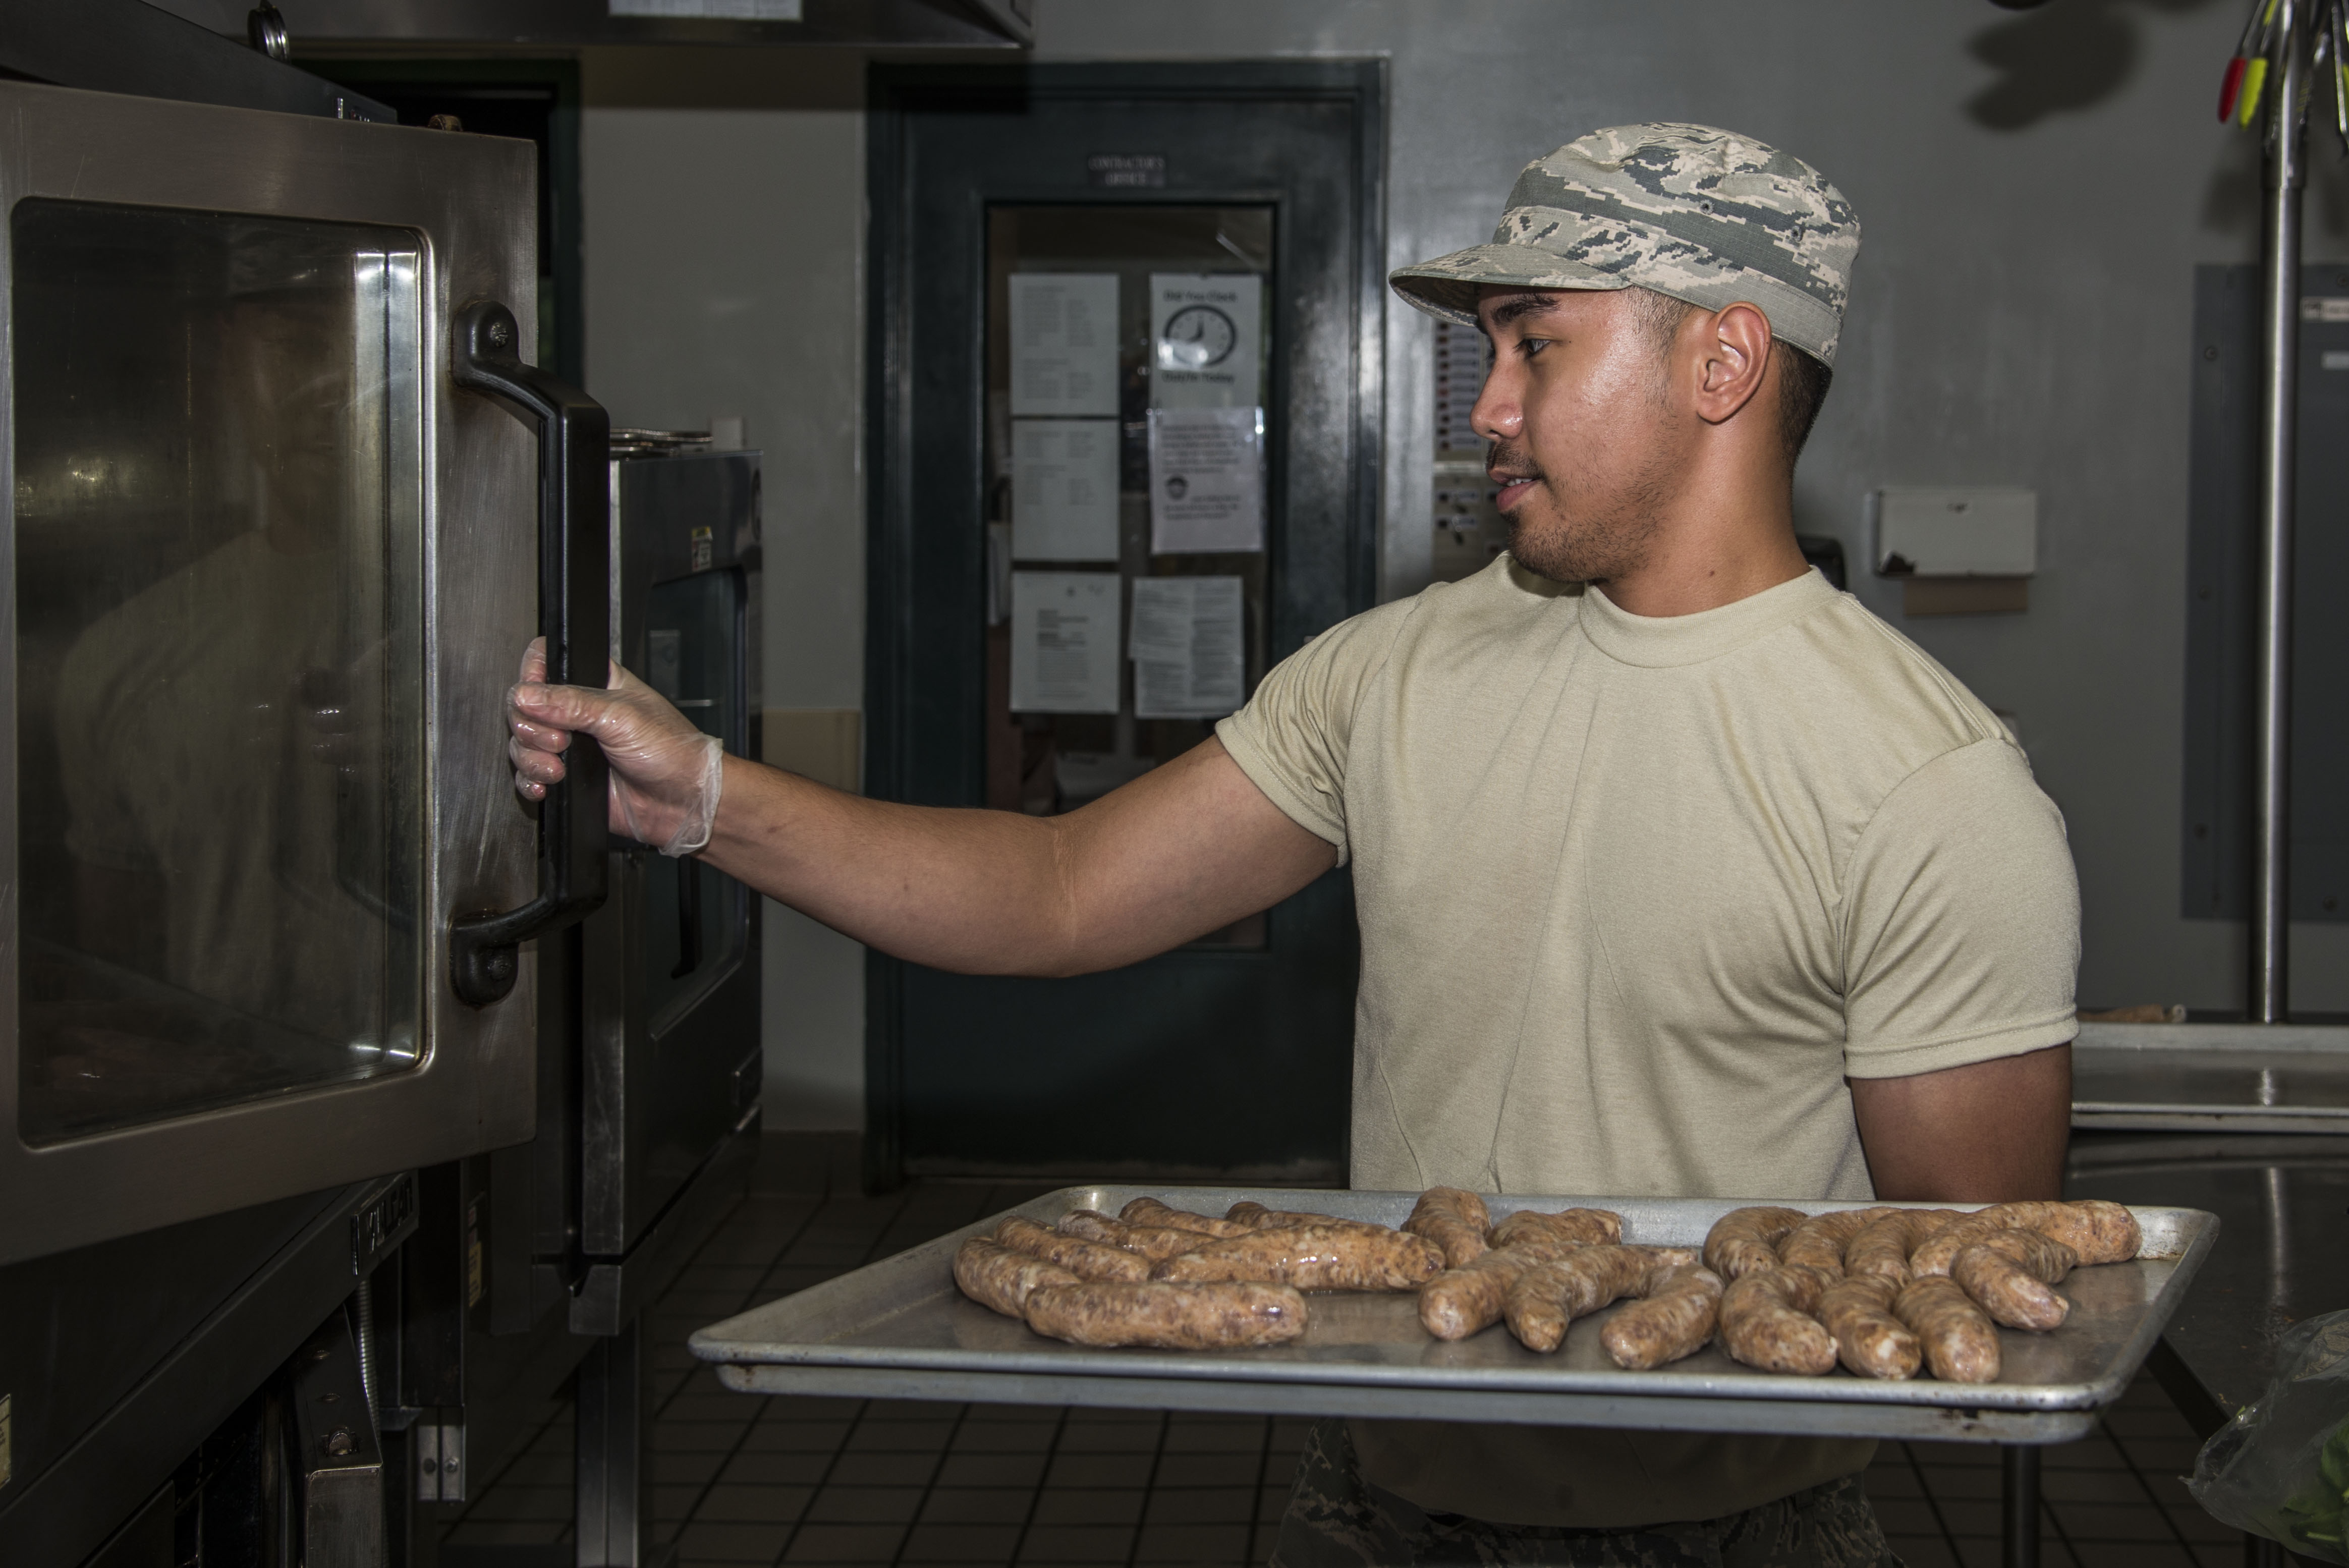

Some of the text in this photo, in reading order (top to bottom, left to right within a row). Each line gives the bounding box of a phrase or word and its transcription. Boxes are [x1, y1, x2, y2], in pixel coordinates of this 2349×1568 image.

[1105, 172, 1146, 186] OFFICE
[1185, 290, 1204, 302] You
[367, 1177, 413, 1255] VULCAN
